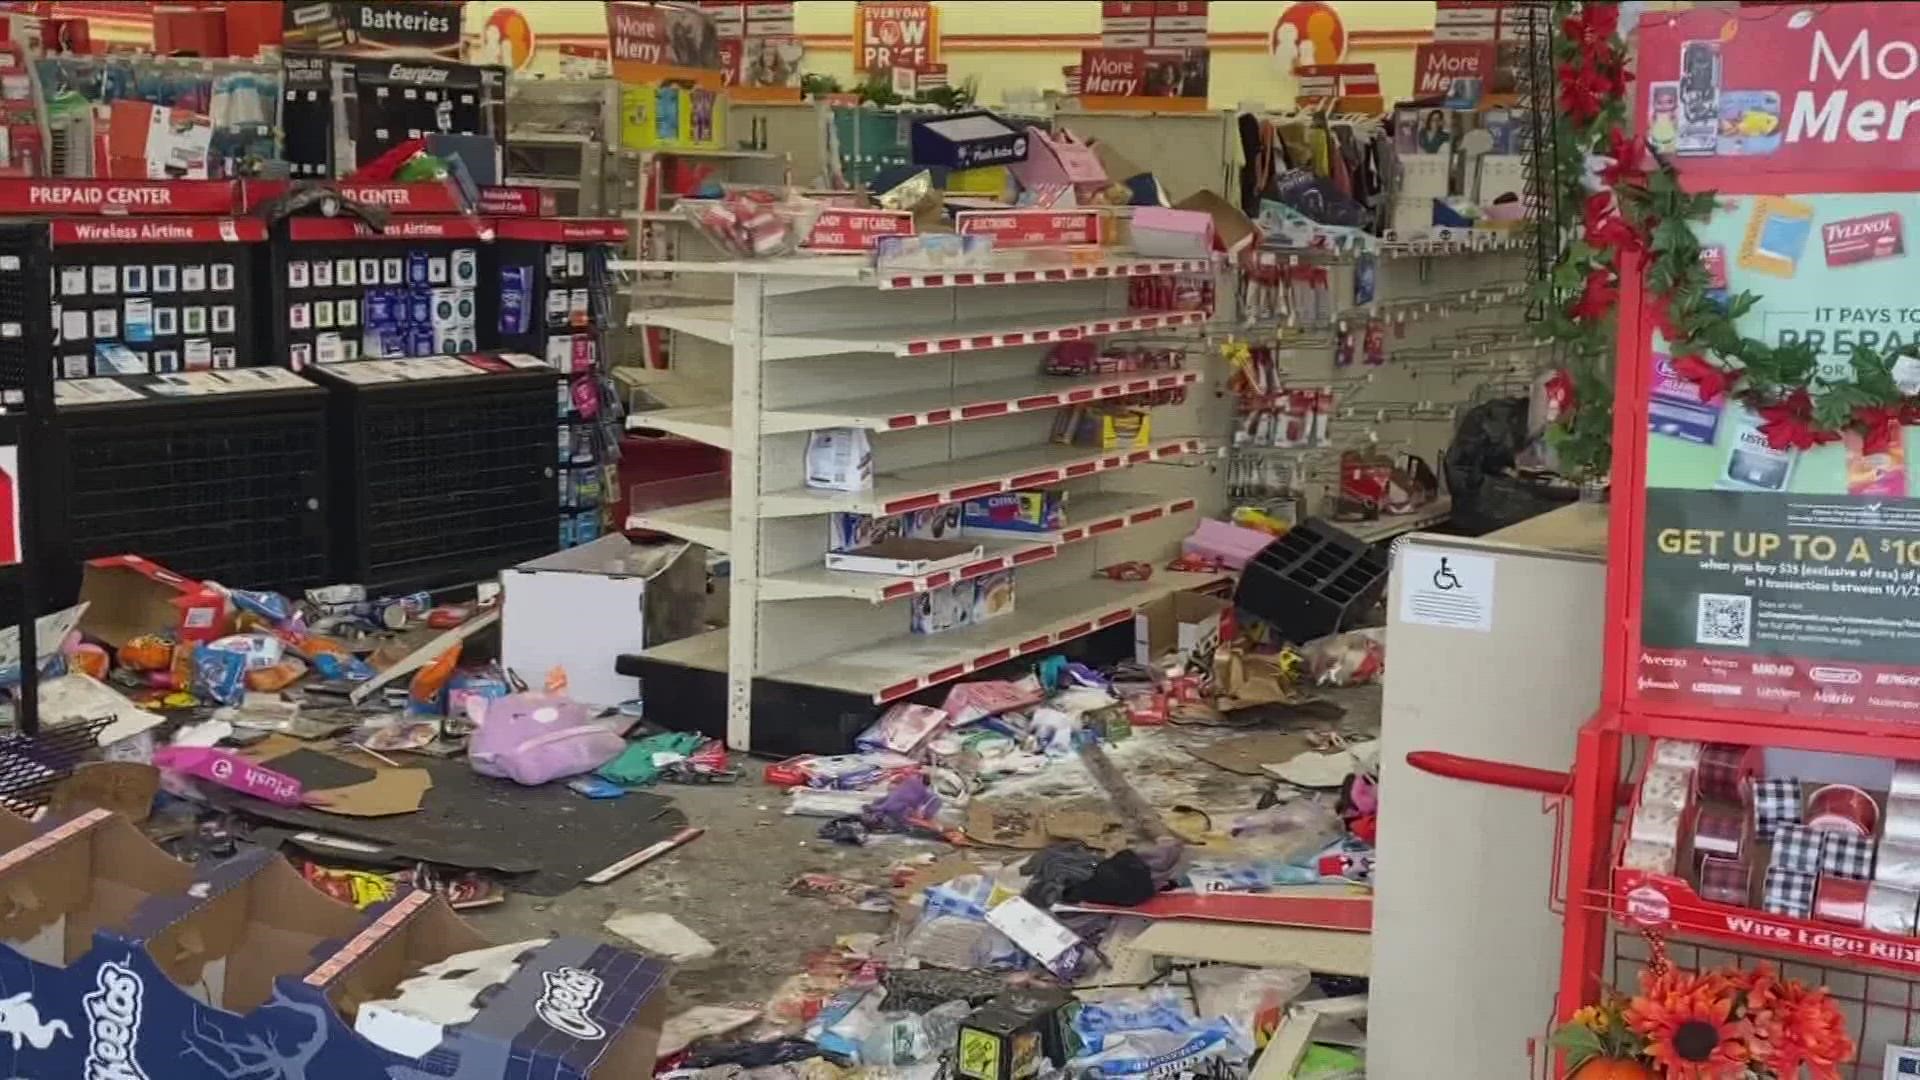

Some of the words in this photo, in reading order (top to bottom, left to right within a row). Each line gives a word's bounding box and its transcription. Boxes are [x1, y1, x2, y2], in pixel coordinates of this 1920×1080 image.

[361, 7, 449, 32] Batteries
[865, 7, 927, 19] EVERYDAY
[616, 15, 656, 38] More
[865, 20, 926, 45] LOW
[616, 37, 661, 65] Merry
[1428, 52, 1479, 72] More
[389, 64, 449, 83] Energizer
[1091, 57, 1134, 74] More
[1086, 75, 1138, 97] Merry
[30, 187, 102, 204] PREPAID
[106, 187, 171, 205] CENTER
[360, 188, 410, 204] CENTER
[75, 223, 138, 240] Wireless
[141, 224, 194, 239] Airtime
[403, 222, 444, 236] Airtime
[1825, 219, 1893, 242] TYLENOL
[1815, 307, 1833, 323] IT
[1839, 308, 1891, 324] PAYS
[1658, 528, 1724, 556] GET
[1733, 531, 1781, 558] UP
[1788, 534, 1837, 562] TO
[1846, 536, 1872, 564] A
[1699, 560, 1730, 572] when
[1732, 563, 1754, 575] you
[1755, 562, 1777, 577] buy
[1860, 567, 1872, 581] of
[1901, 569, 1915, 582] of
[1766, 579, 1830, 592] transaction
[1832, 581, 1883, 595] between
[245, 767, 298, 799] Plush
[1726, 914, 1792, 942] Wire
[1798, 928, 1865, 957] Edge
[537, 968, 604, 1038] Cheetos
